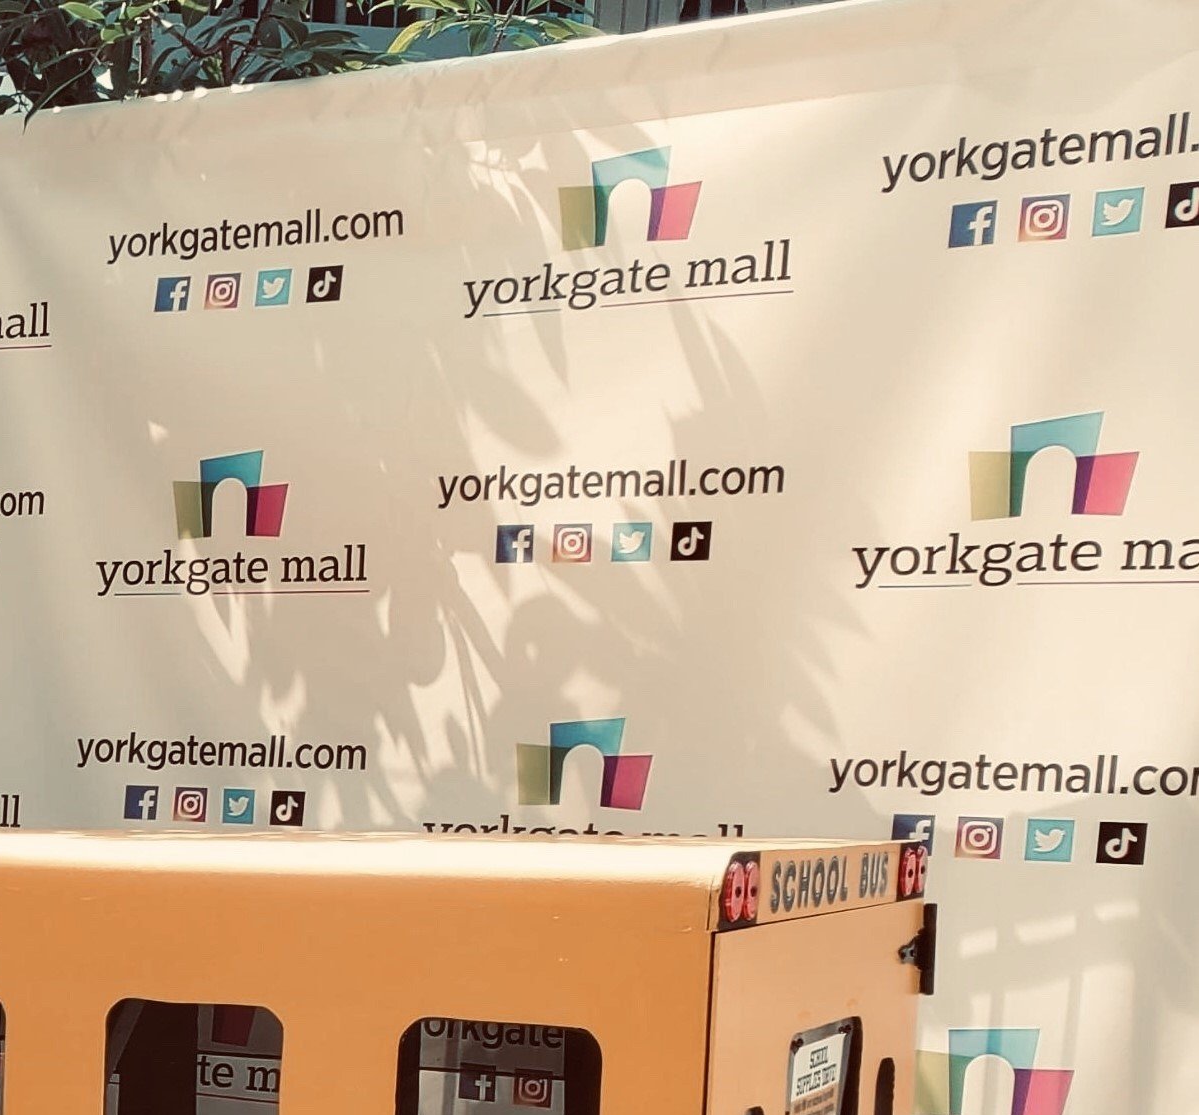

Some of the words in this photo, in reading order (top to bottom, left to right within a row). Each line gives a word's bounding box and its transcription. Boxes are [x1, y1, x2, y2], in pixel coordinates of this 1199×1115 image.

[106, 208, 404, 266] yorkgatemall.com
[463, 255, 671, 319] yorkgate
[685, 239, 792, 288] mall
[438, 459, 785, 509] yorkgatemall.com
[96, 549, 269, 596] yorkgate
[280, 544, 369, 585] mall
[852, 531, 1103, 588] yorkgate
[76, 731, 368, 772] yorkgatemall.com
[770, 855, 849, 914] SCHOOL
[859, 852, 890, 898] BUS
